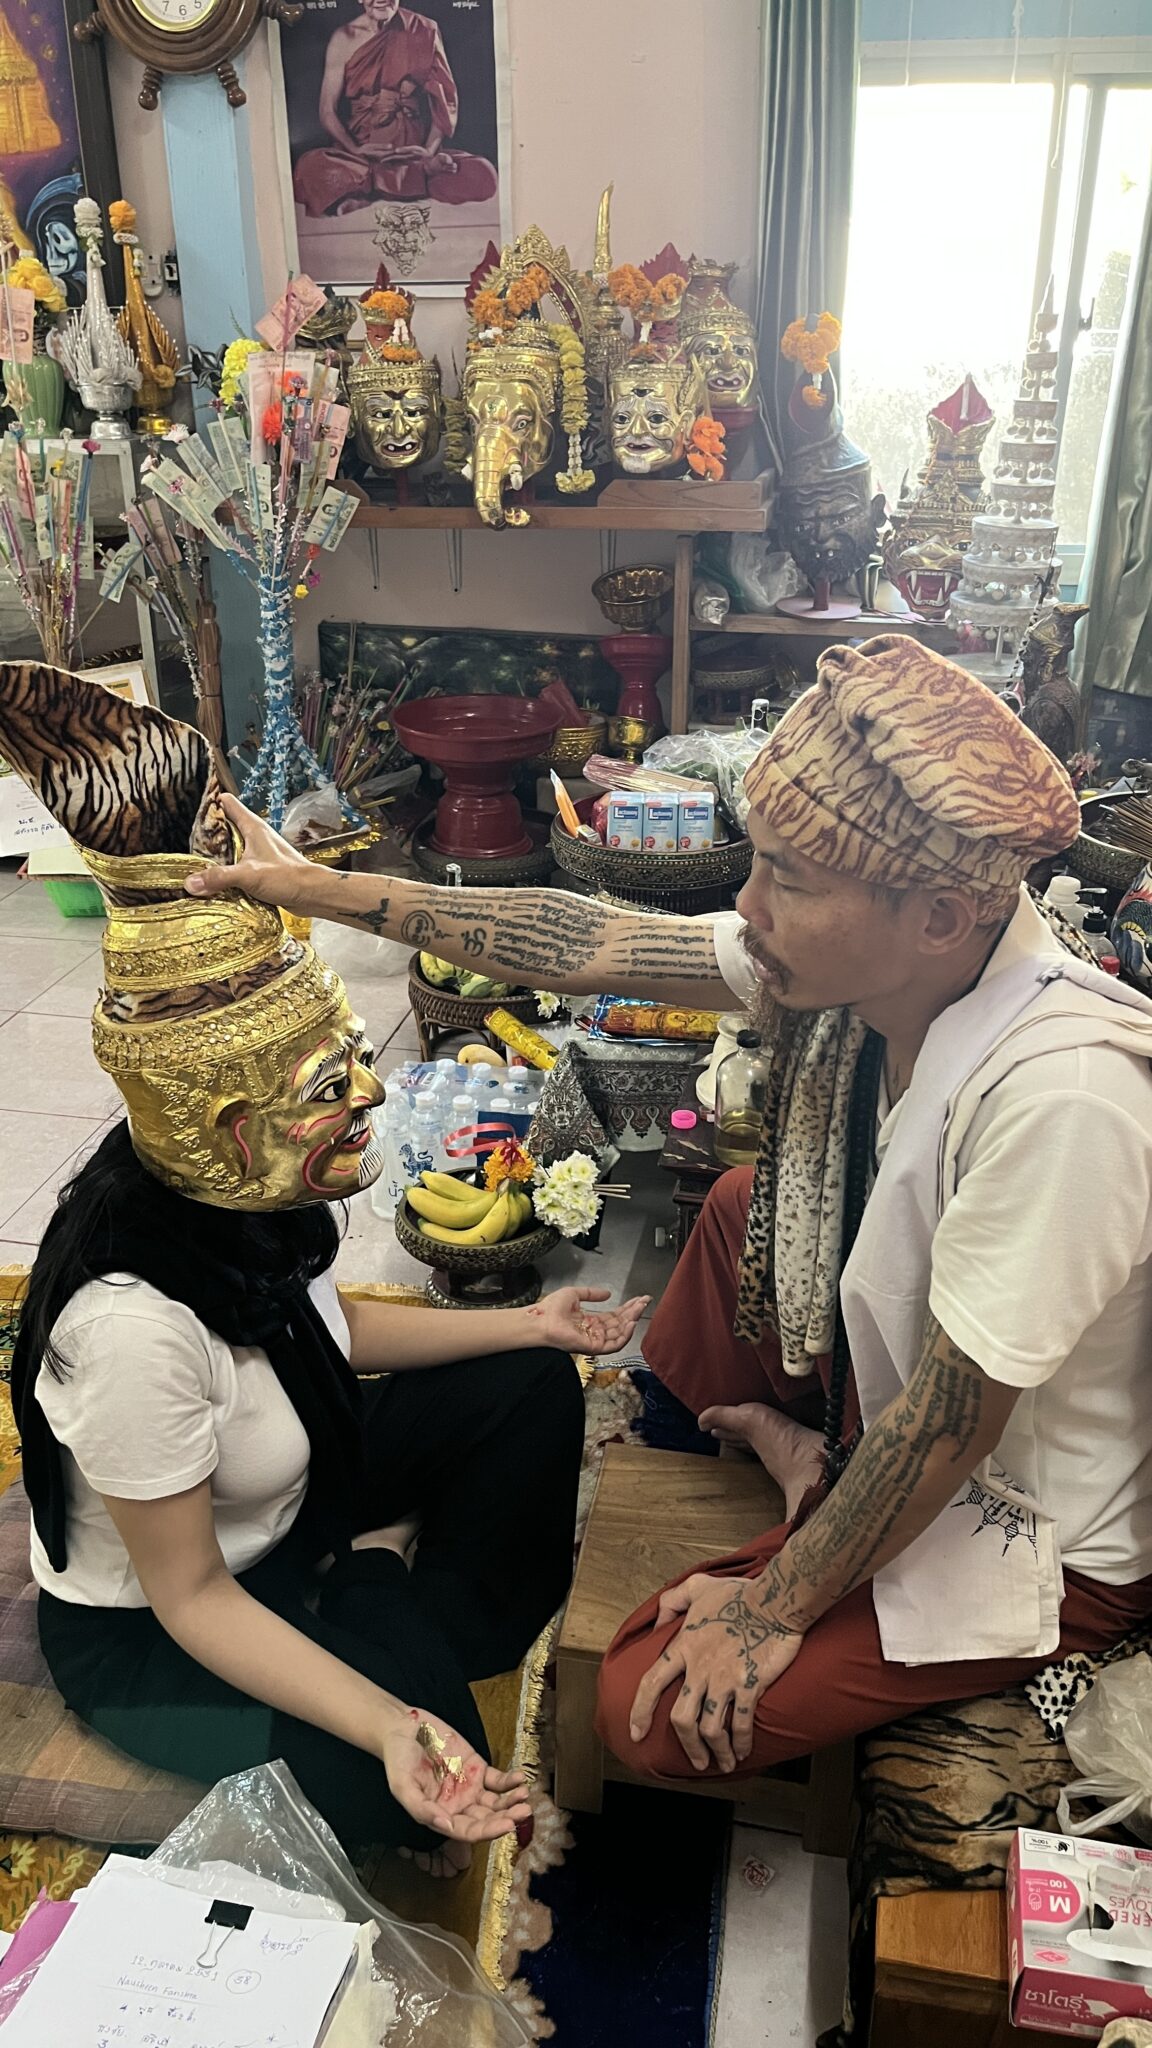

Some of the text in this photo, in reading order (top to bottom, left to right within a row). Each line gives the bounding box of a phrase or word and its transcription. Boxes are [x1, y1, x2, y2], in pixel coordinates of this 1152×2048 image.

[162, 1, 170, 12] 7
[194, 0, 202, 9] 5
[179, 5, 187, 15] 6
[1049, 1879, 1068, 1889] 100
[1049, 1895, 1071, 1914] M
